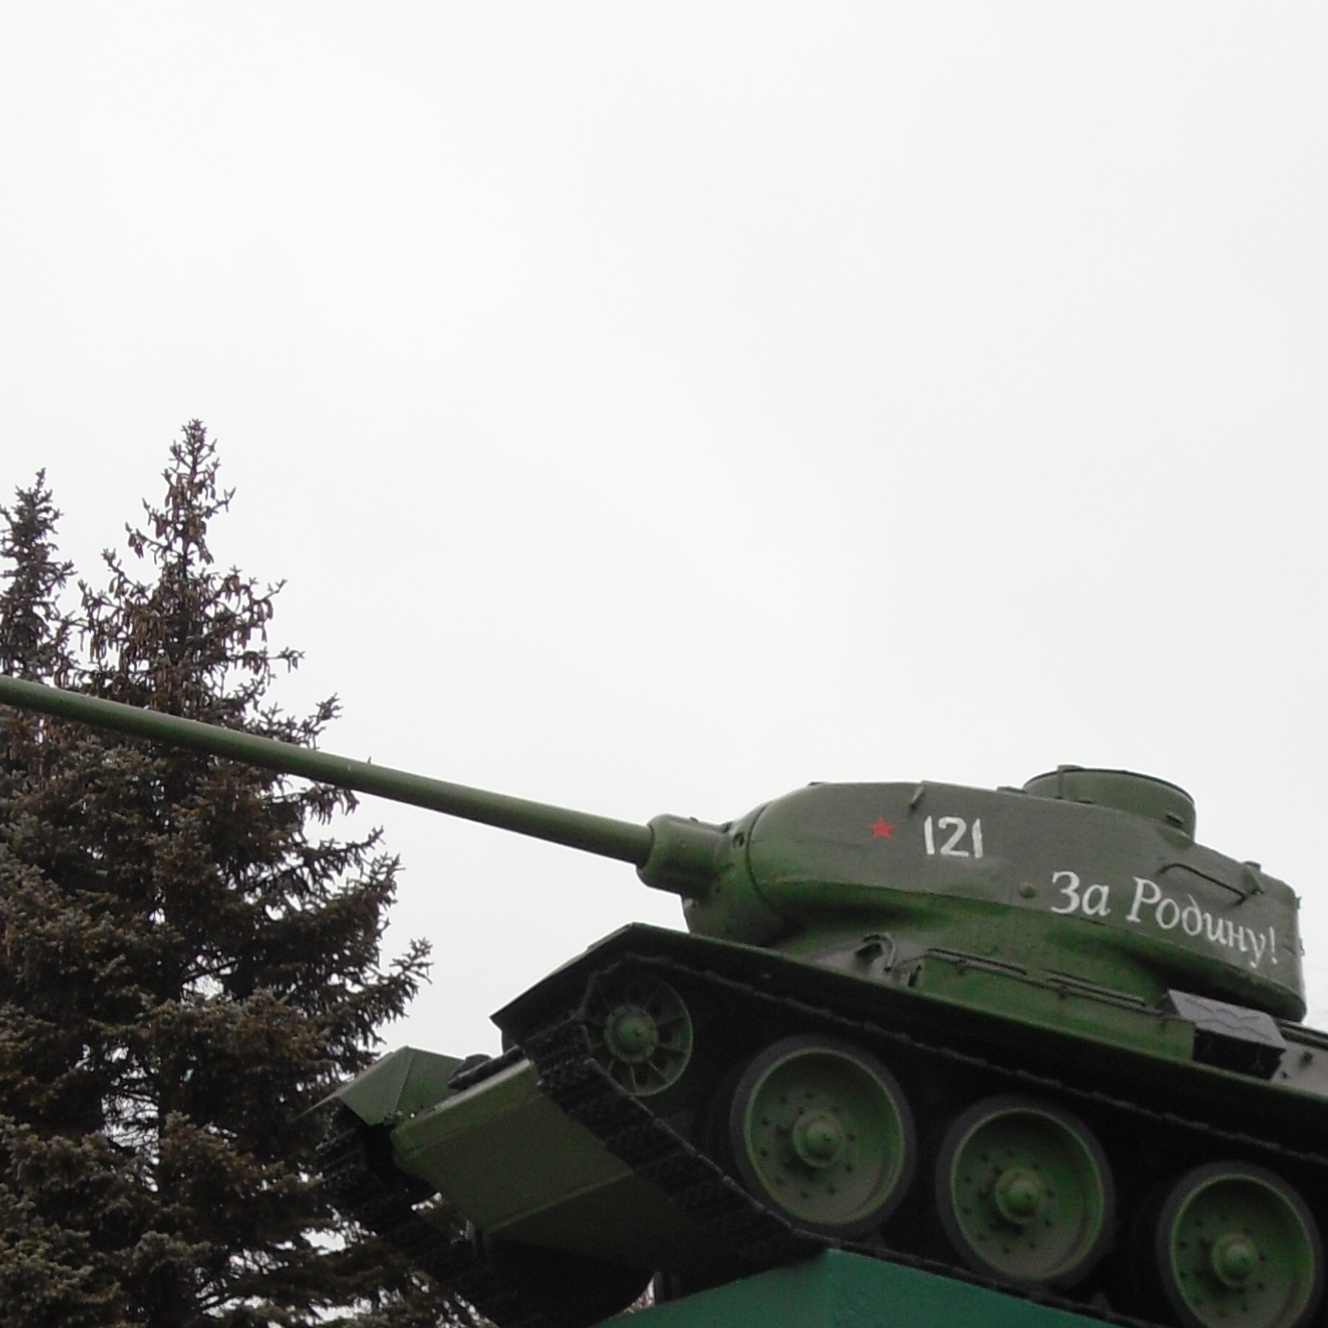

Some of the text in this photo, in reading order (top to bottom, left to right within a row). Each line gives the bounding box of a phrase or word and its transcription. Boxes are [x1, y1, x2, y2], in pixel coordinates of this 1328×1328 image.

[924, 815, 983, 859] 121
[1051, 870, 1278, 968] За Родину!
